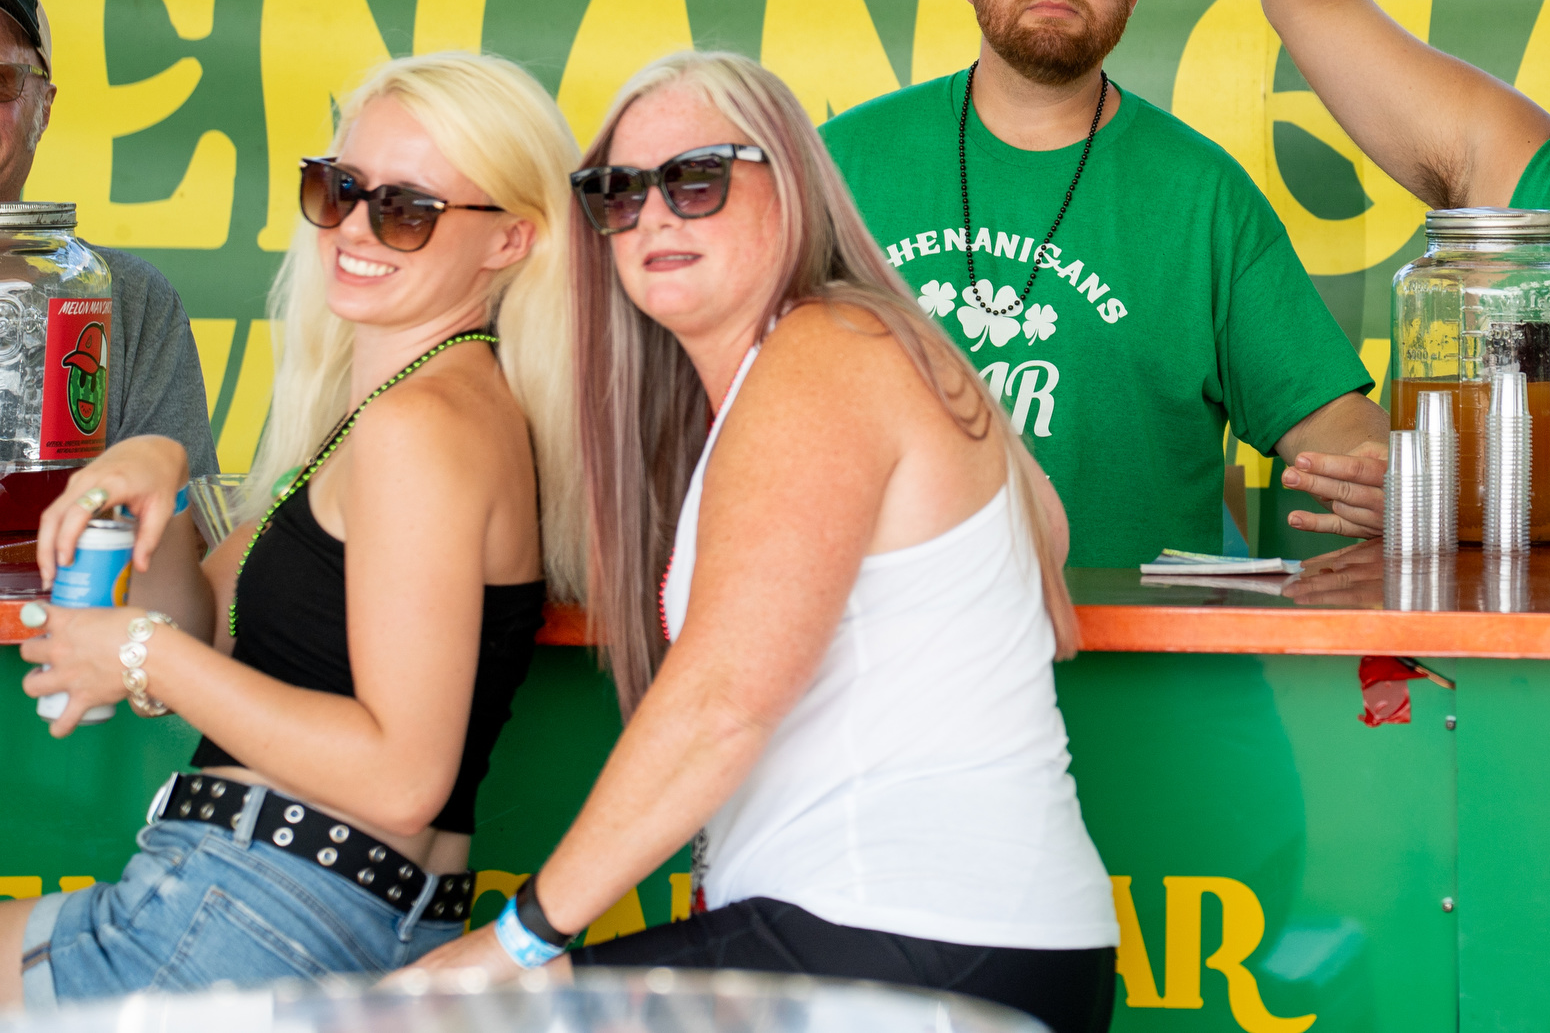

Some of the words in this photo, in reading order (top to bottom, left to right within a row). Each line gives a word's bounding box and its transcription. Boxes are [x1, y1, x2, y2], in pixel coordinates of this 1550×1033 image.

[58, 301, 90, 315] MELON
[887, 227, 1129, 324] HENANIGANS
[1110, 875, 1317, 1033] AR
